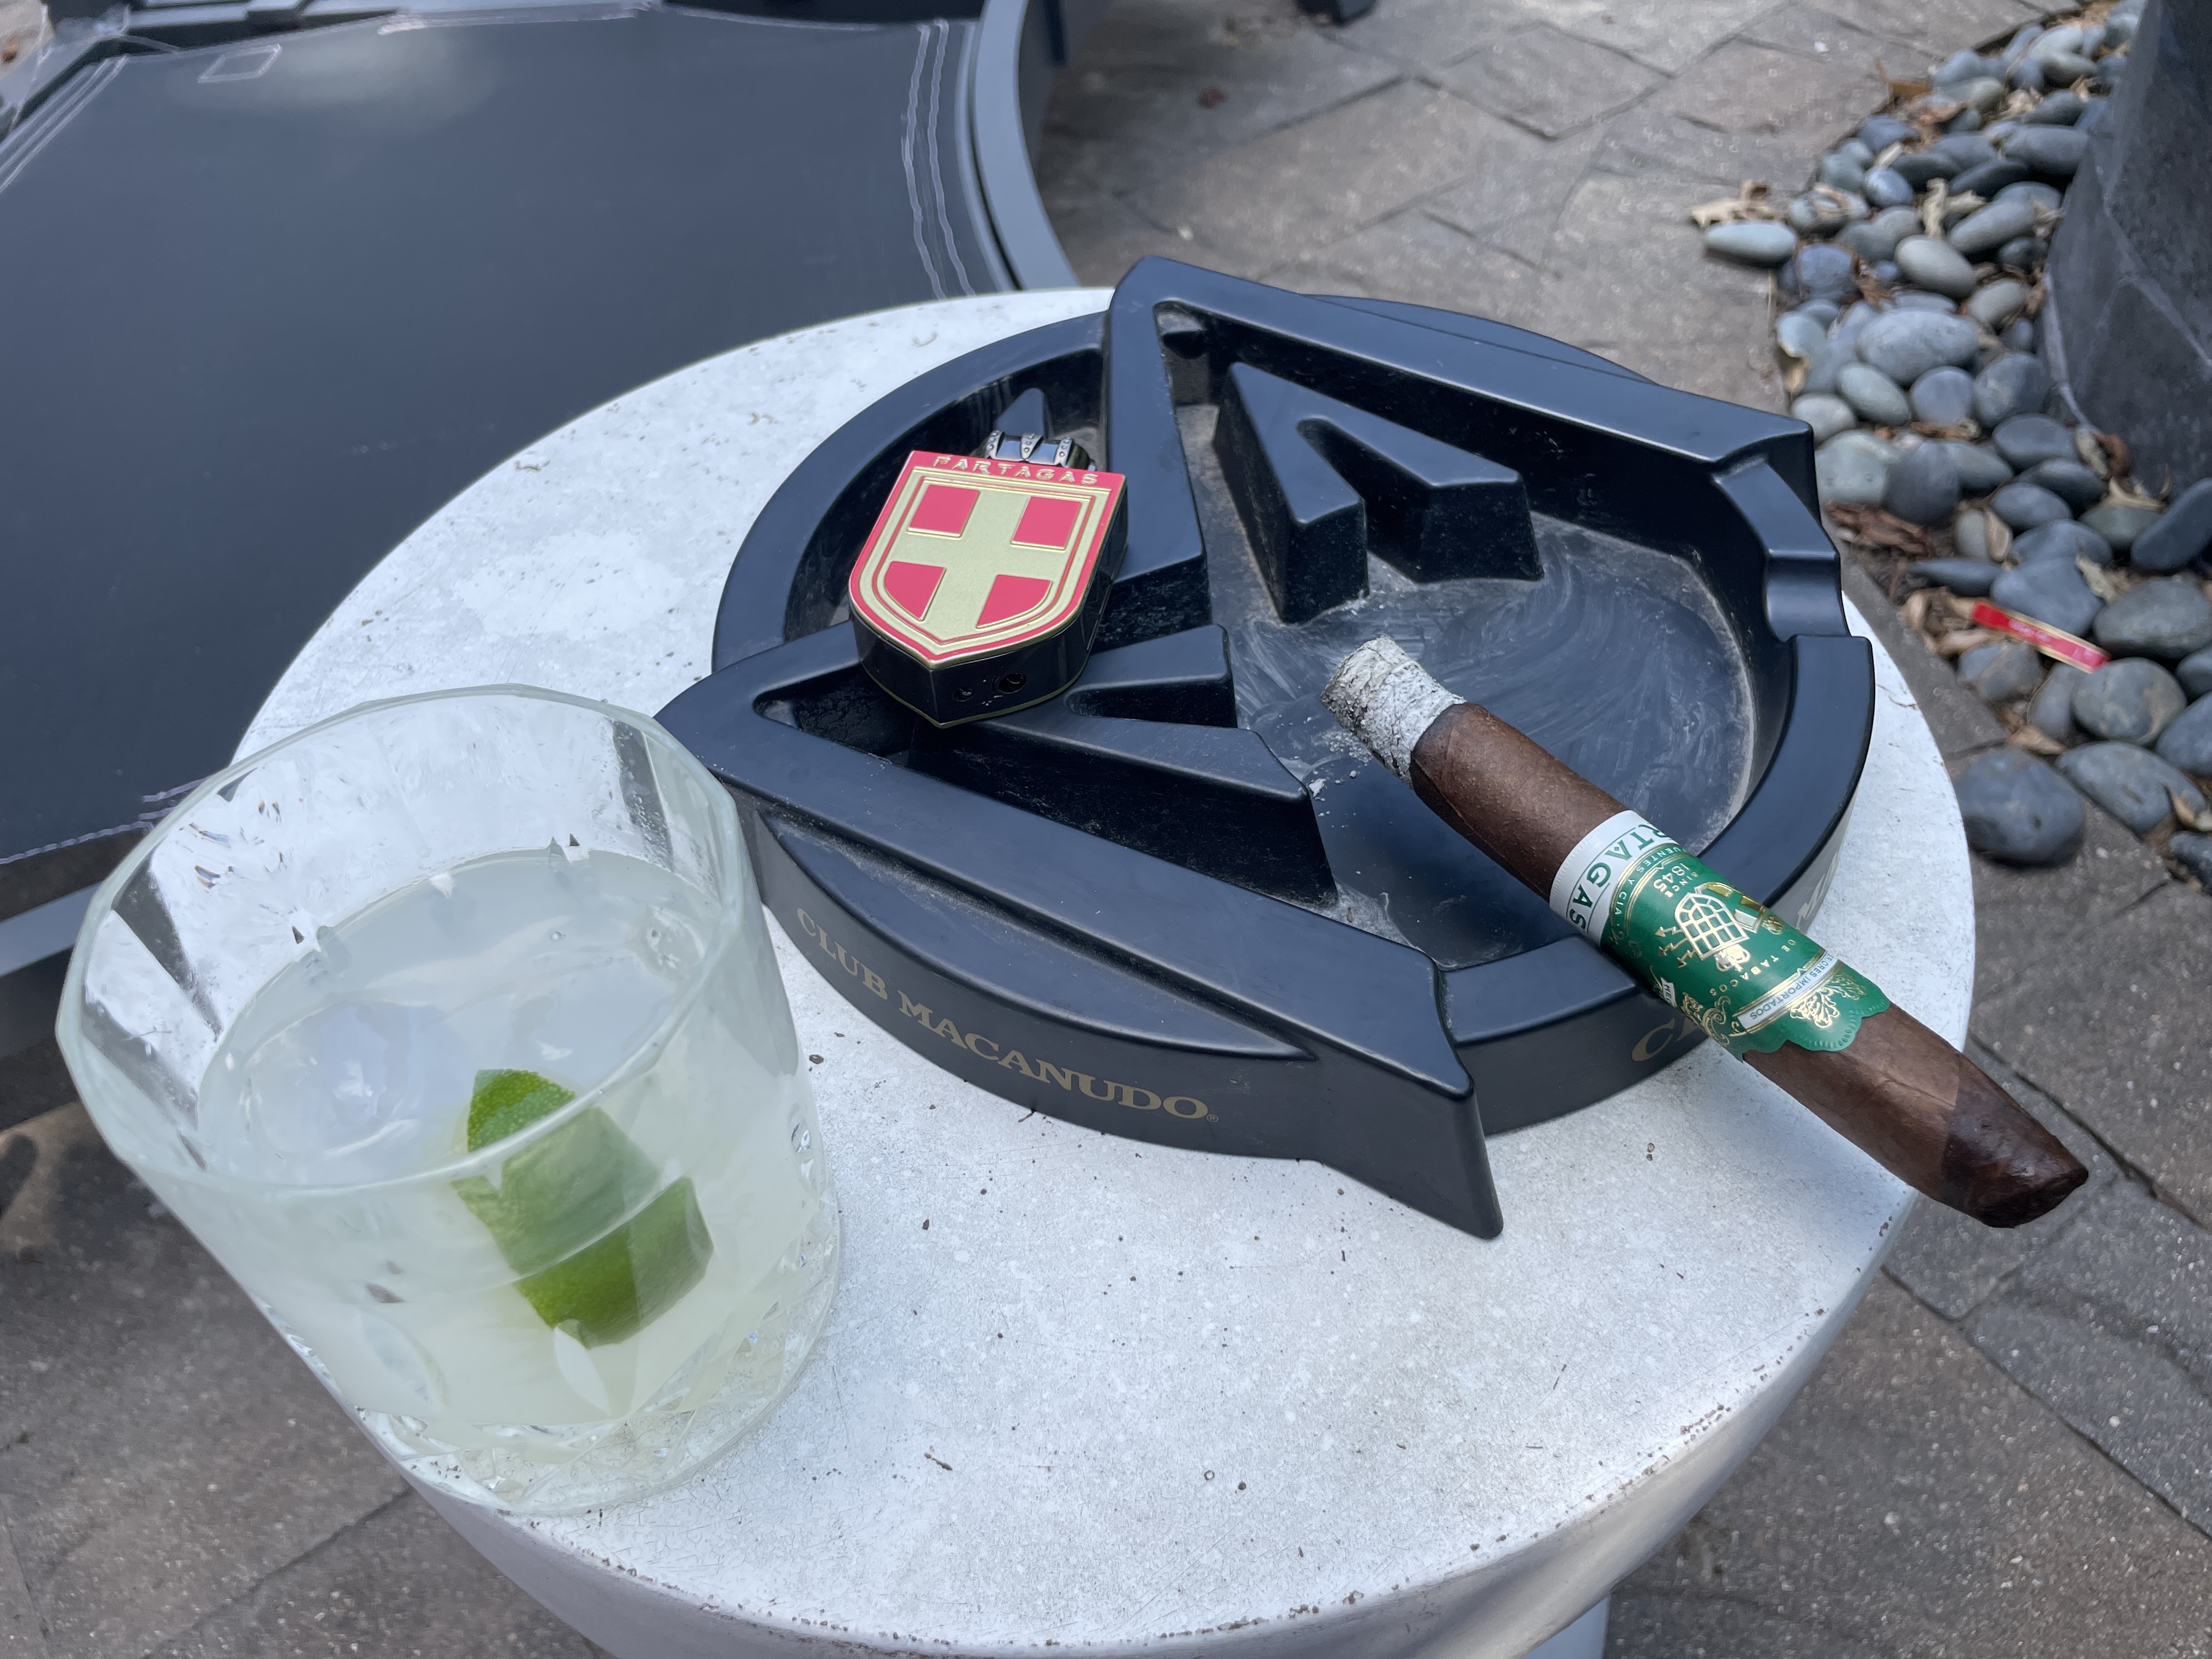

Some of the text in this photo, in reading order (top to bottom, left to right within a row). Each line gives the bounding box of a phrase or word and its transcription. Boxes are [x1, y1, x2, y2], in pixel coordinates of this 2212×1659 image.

[933, 455, 1098, 485] PARTAGAS
[1636, 847, 1687, 873] UENTES
[1653, 863, 1690, 893] 1845
[1615, 891, 1627, 915] CIA
[797, 908, 888, 1000] CLUB
[1709, 939, 1796, 996] DE TABACOS
[1750, 975, 1811, 1020] IMPORTADOS
